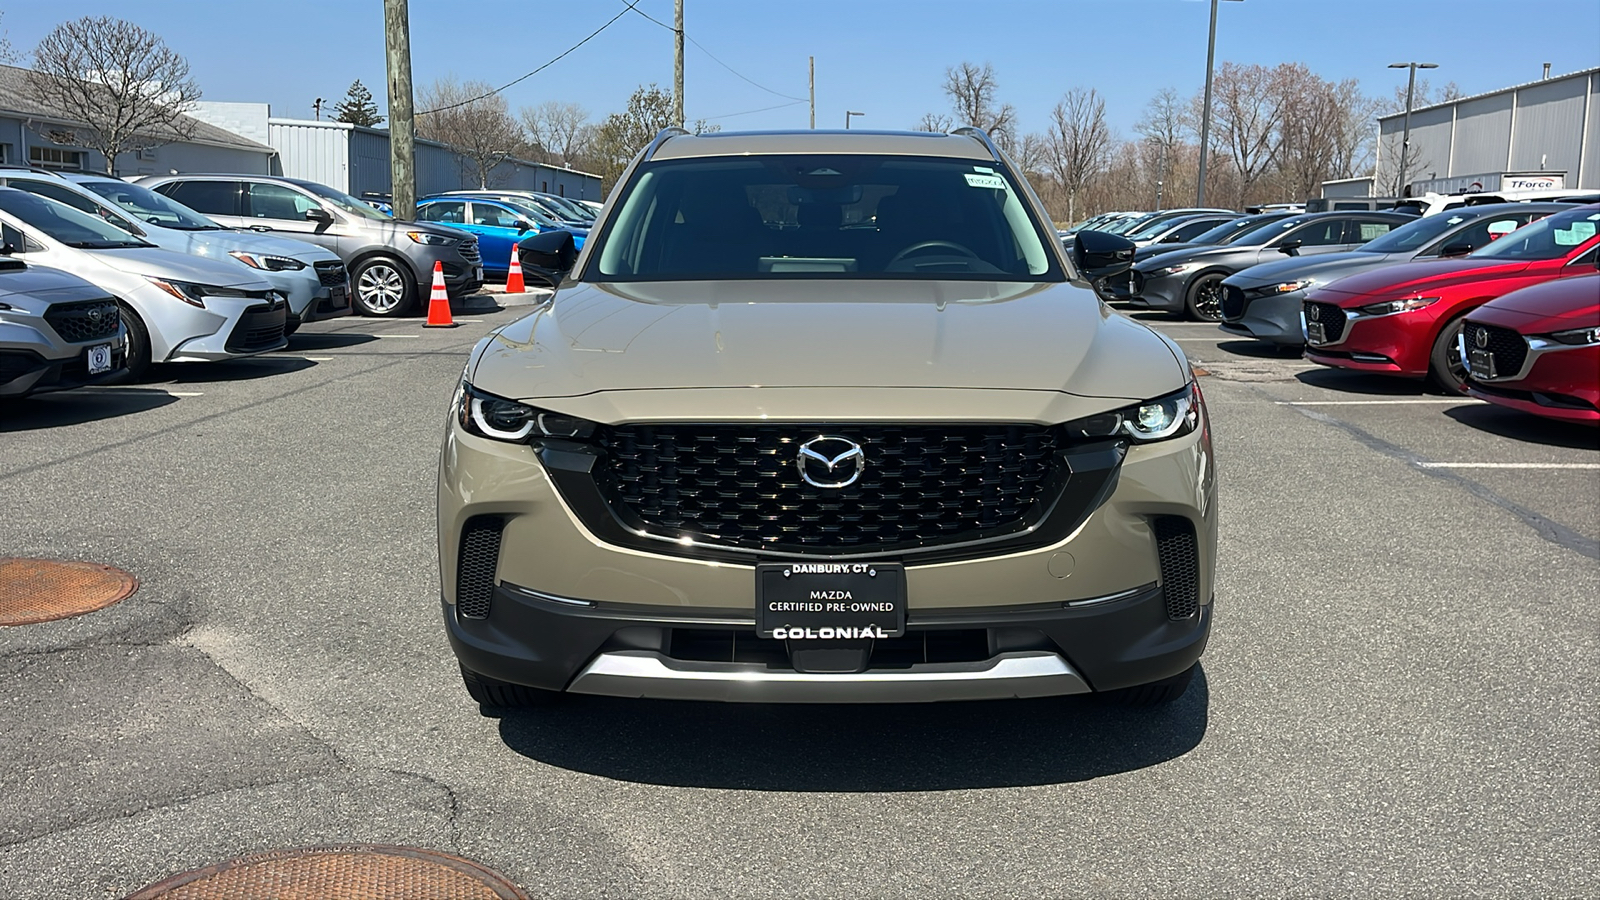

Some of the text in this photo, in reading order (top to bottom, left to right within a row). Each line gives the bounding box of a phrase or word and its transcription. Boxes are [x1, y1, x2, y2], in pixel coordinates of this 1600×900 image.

[792, 564, 869, 574] DANBURY, CT
[810, 591, 853, 600] MAZDA
[769, 602, 894, 612] CERTIFIED PRE-OWNED
[772, 627, 889, 640] COLONIAL
